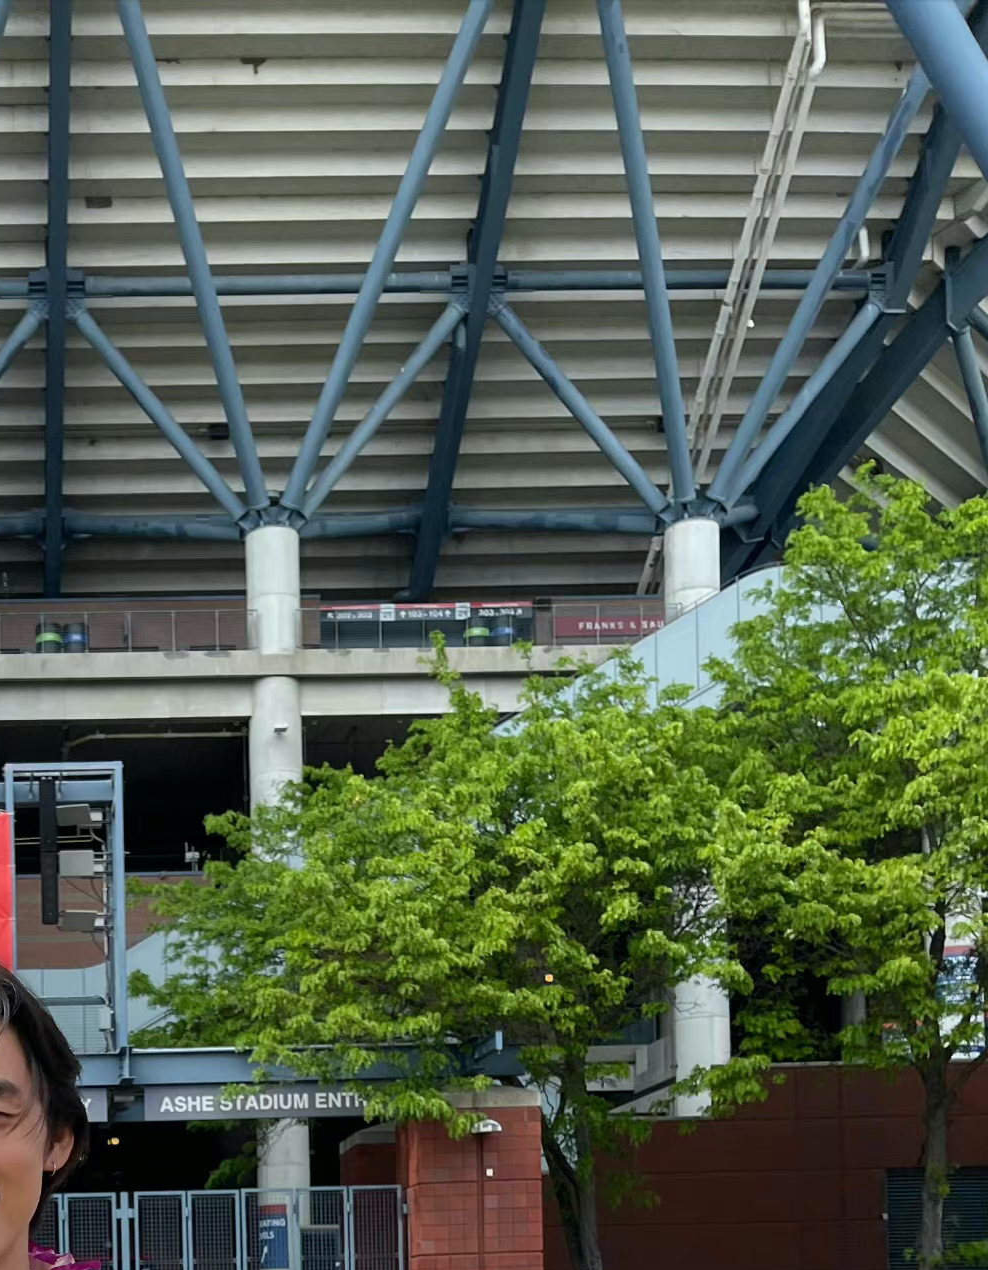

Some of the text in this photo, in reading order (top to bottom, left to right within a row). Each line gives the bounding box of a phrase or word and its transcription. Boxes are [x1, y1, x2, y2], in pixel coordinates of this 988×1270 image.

[578, 621, 624, 630] FRANKS
[160, 1096, 215, 1113] ASHE
[220, 1093, 309, 1112] STADIUM
